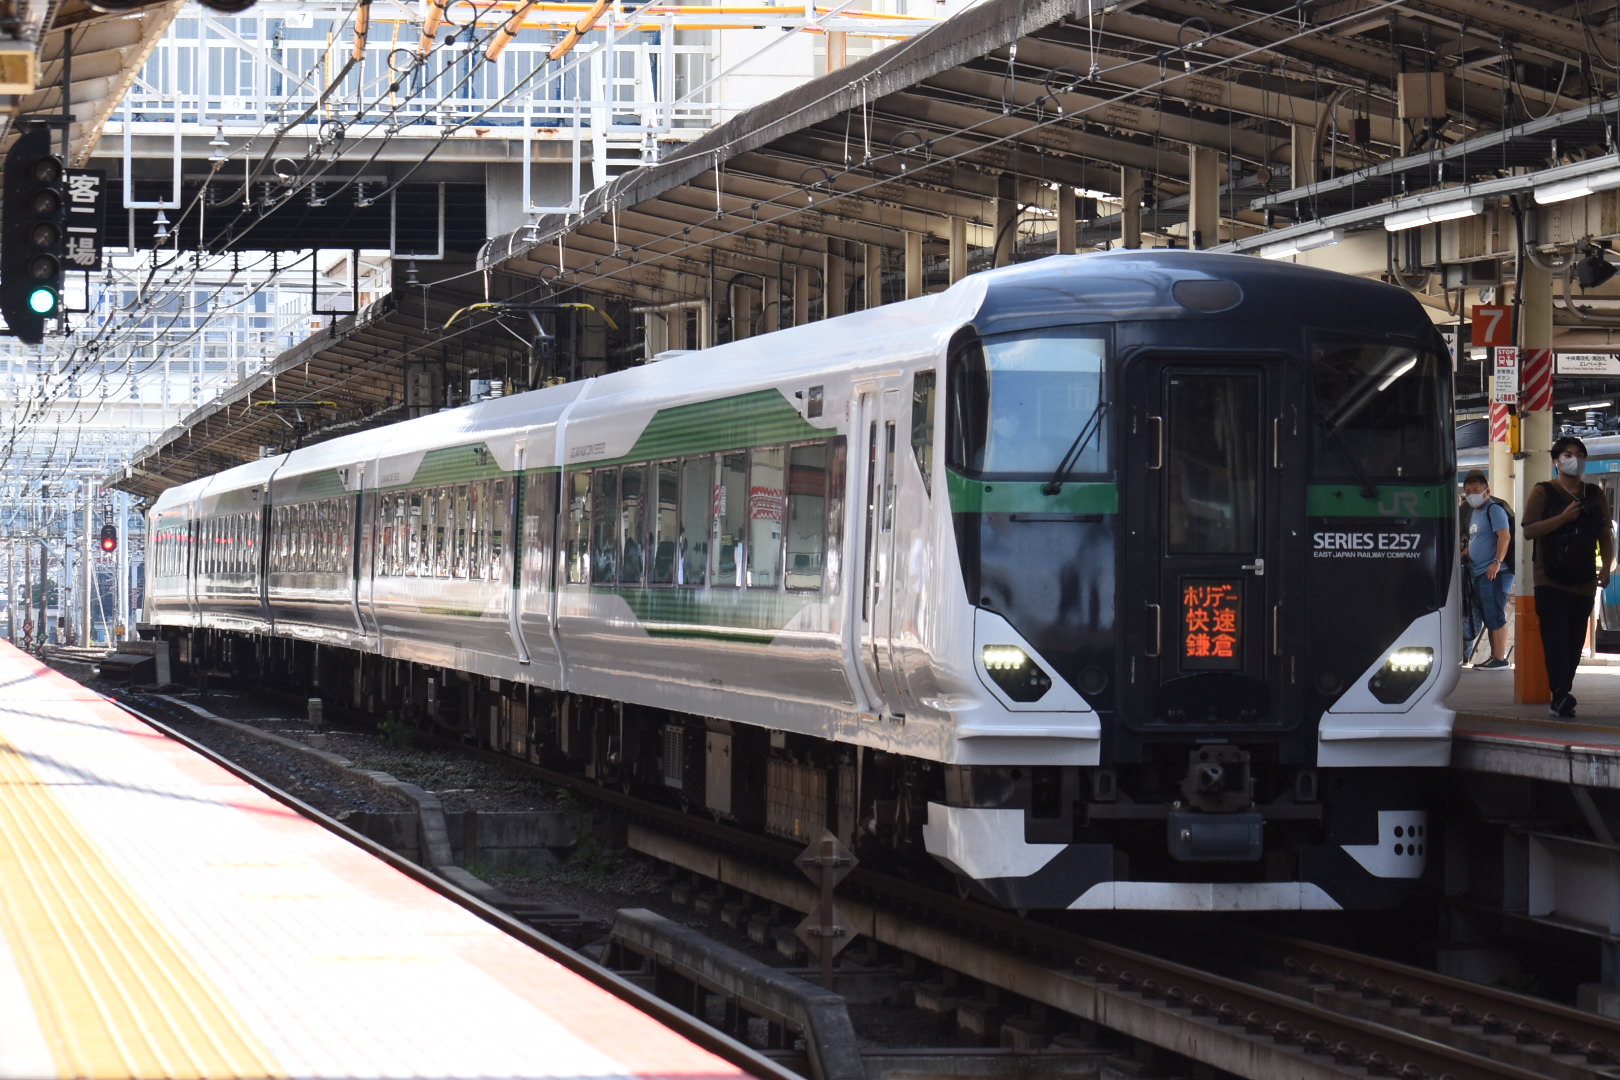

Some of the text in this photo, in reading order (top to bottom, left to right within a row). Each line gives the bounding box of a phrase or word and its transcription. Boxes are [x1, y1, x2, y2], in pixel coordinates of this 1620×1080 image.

[66, 174, 100, 266] 客二場
[1479, 309, 1504, 343] 7
[1377, 491, 1419, 516] JR
[1313, 532, 1421, 550] SERIES E257
[1386, 551, 1421, 559] COMPANY
[1184, 585, 1238, 607] ホリデー
[1186, 608, 1236, 632] 快速
[1186, 633, 1236, 657] 鎌倉
